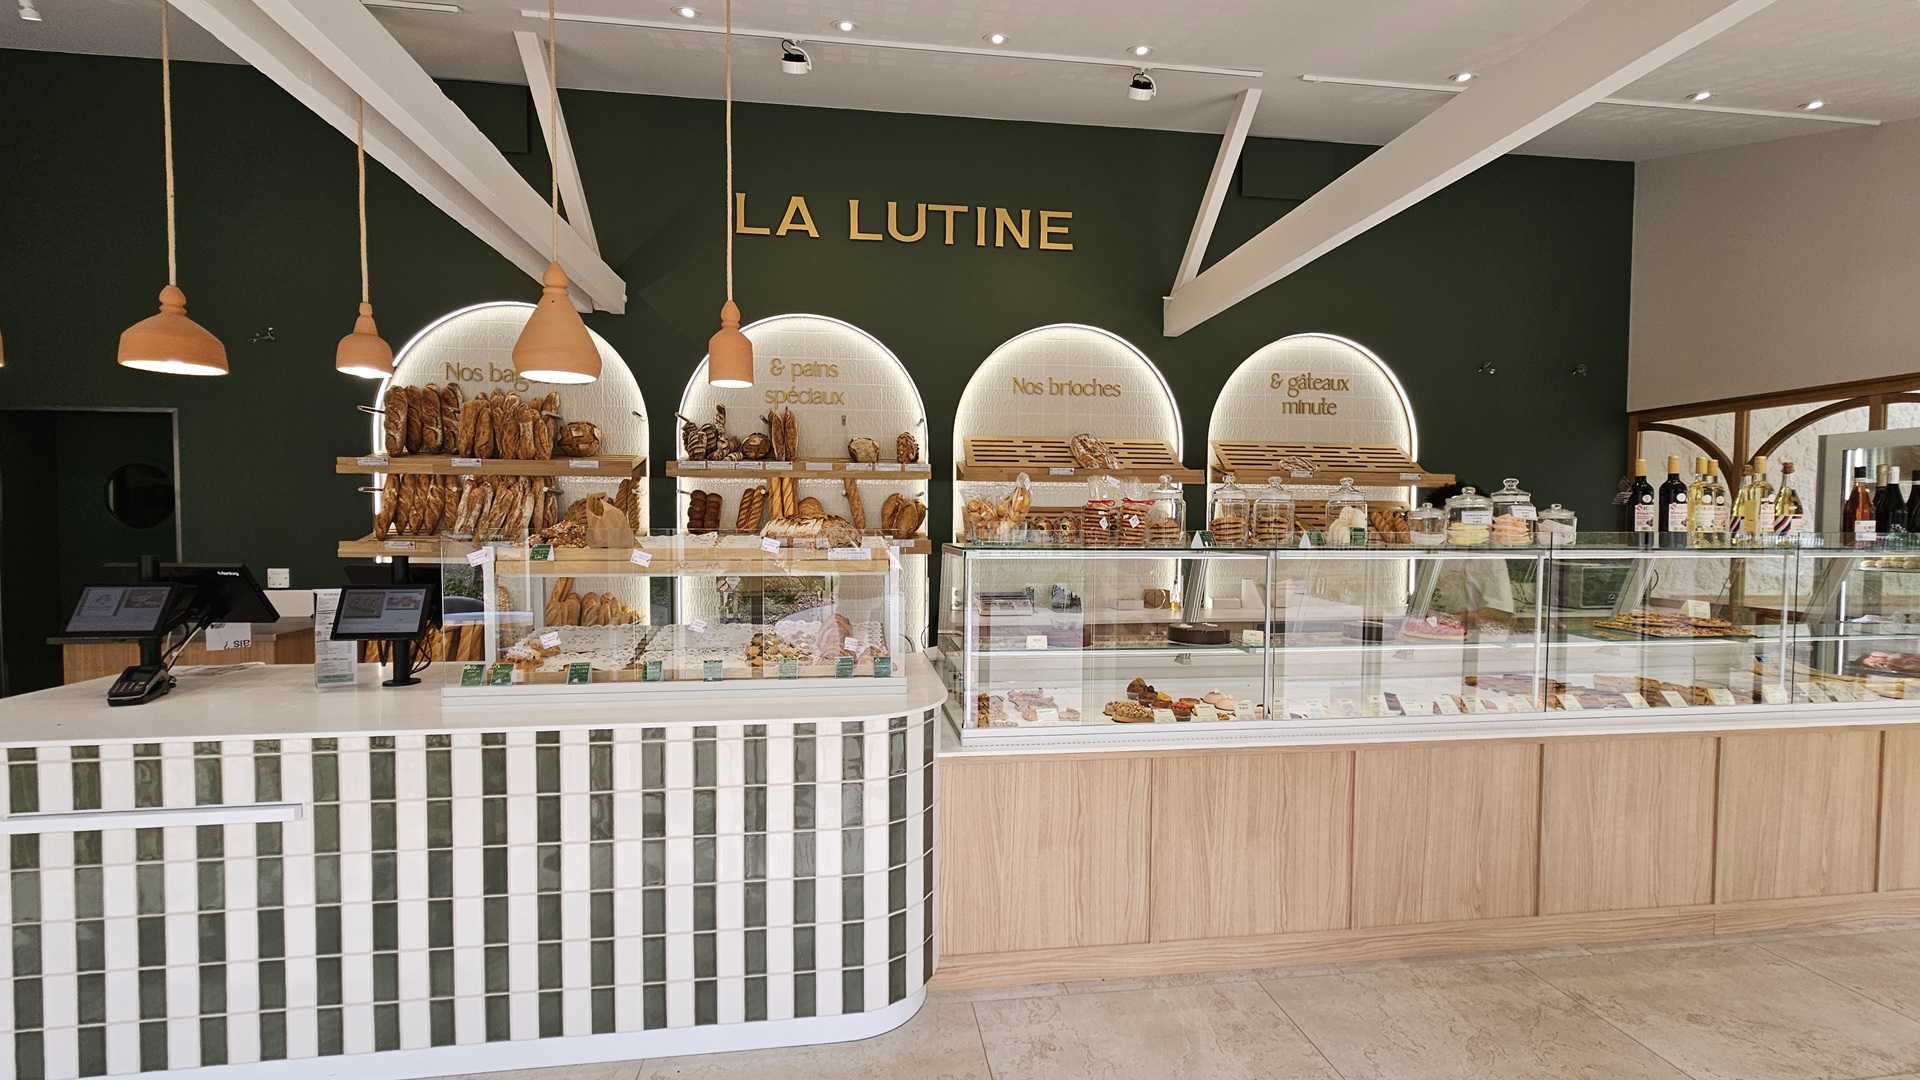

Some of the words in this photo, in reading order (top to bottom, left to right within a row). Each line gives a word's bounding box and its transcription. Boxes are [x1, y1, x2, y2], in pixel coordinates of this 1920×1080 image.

[735, 192, 820, 238] LA
[848, 199, 1074, 251] LUTINE
[445, 361, 484, 382] Nos
[769, 357, 785, 376] &
[790, 360, 839, 382] pains
[764, 385, 845, 409] spéciaux
[1012, 376, 1044, 395] Nos
[1048, 376, 1121, 397] brioches
[1270, 372, 1283, 389] &
[1287, 372, 1349, 398] gâteaux
[1281, 397, 1337, 415] minute
